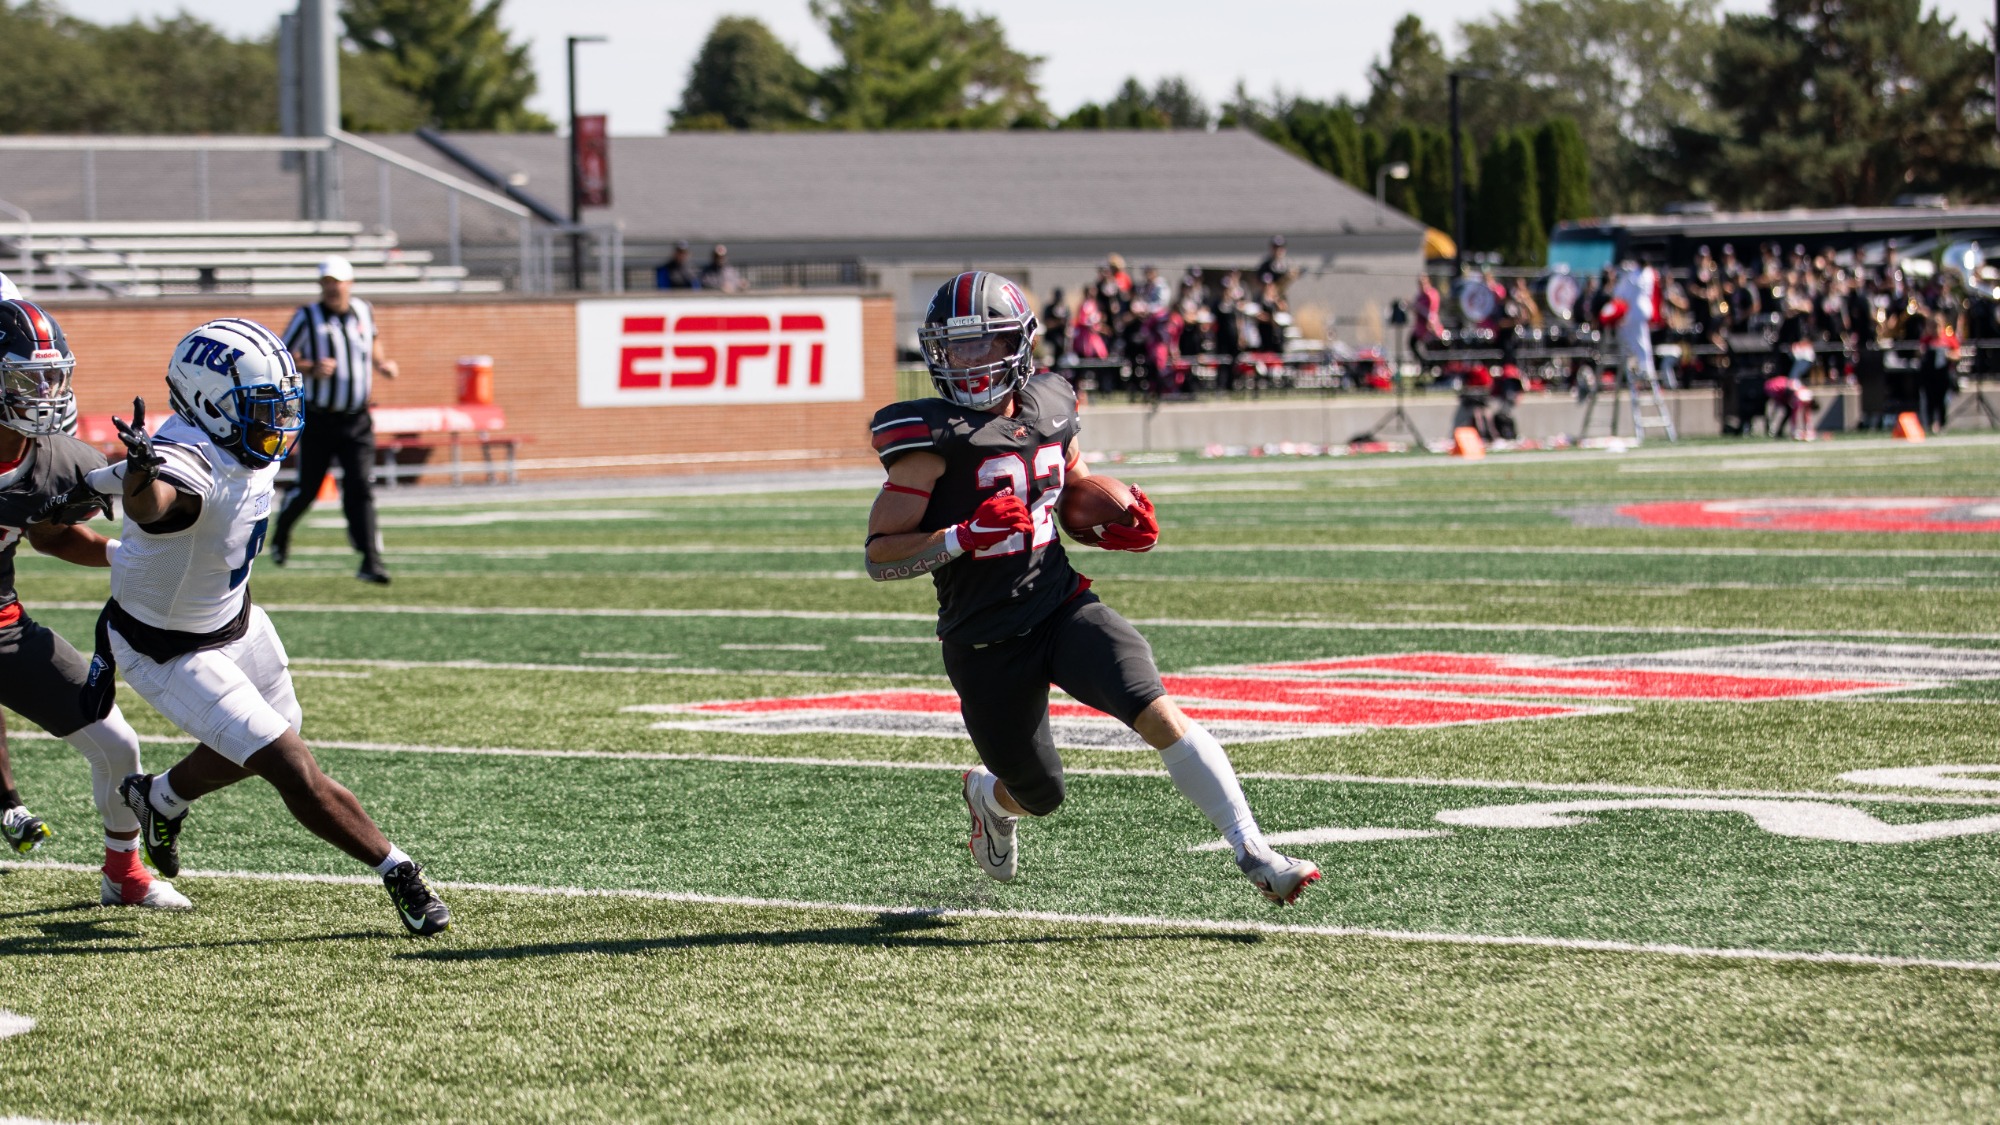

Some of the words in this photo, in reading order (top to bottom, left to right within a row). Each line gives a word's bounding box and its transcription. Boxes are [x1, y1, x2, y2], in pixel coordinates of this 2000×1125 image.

[619, 315, 825, 389] ESPN
[952, 317, 976, 326] VICIS
[972, 441, 1066, 560] 22
